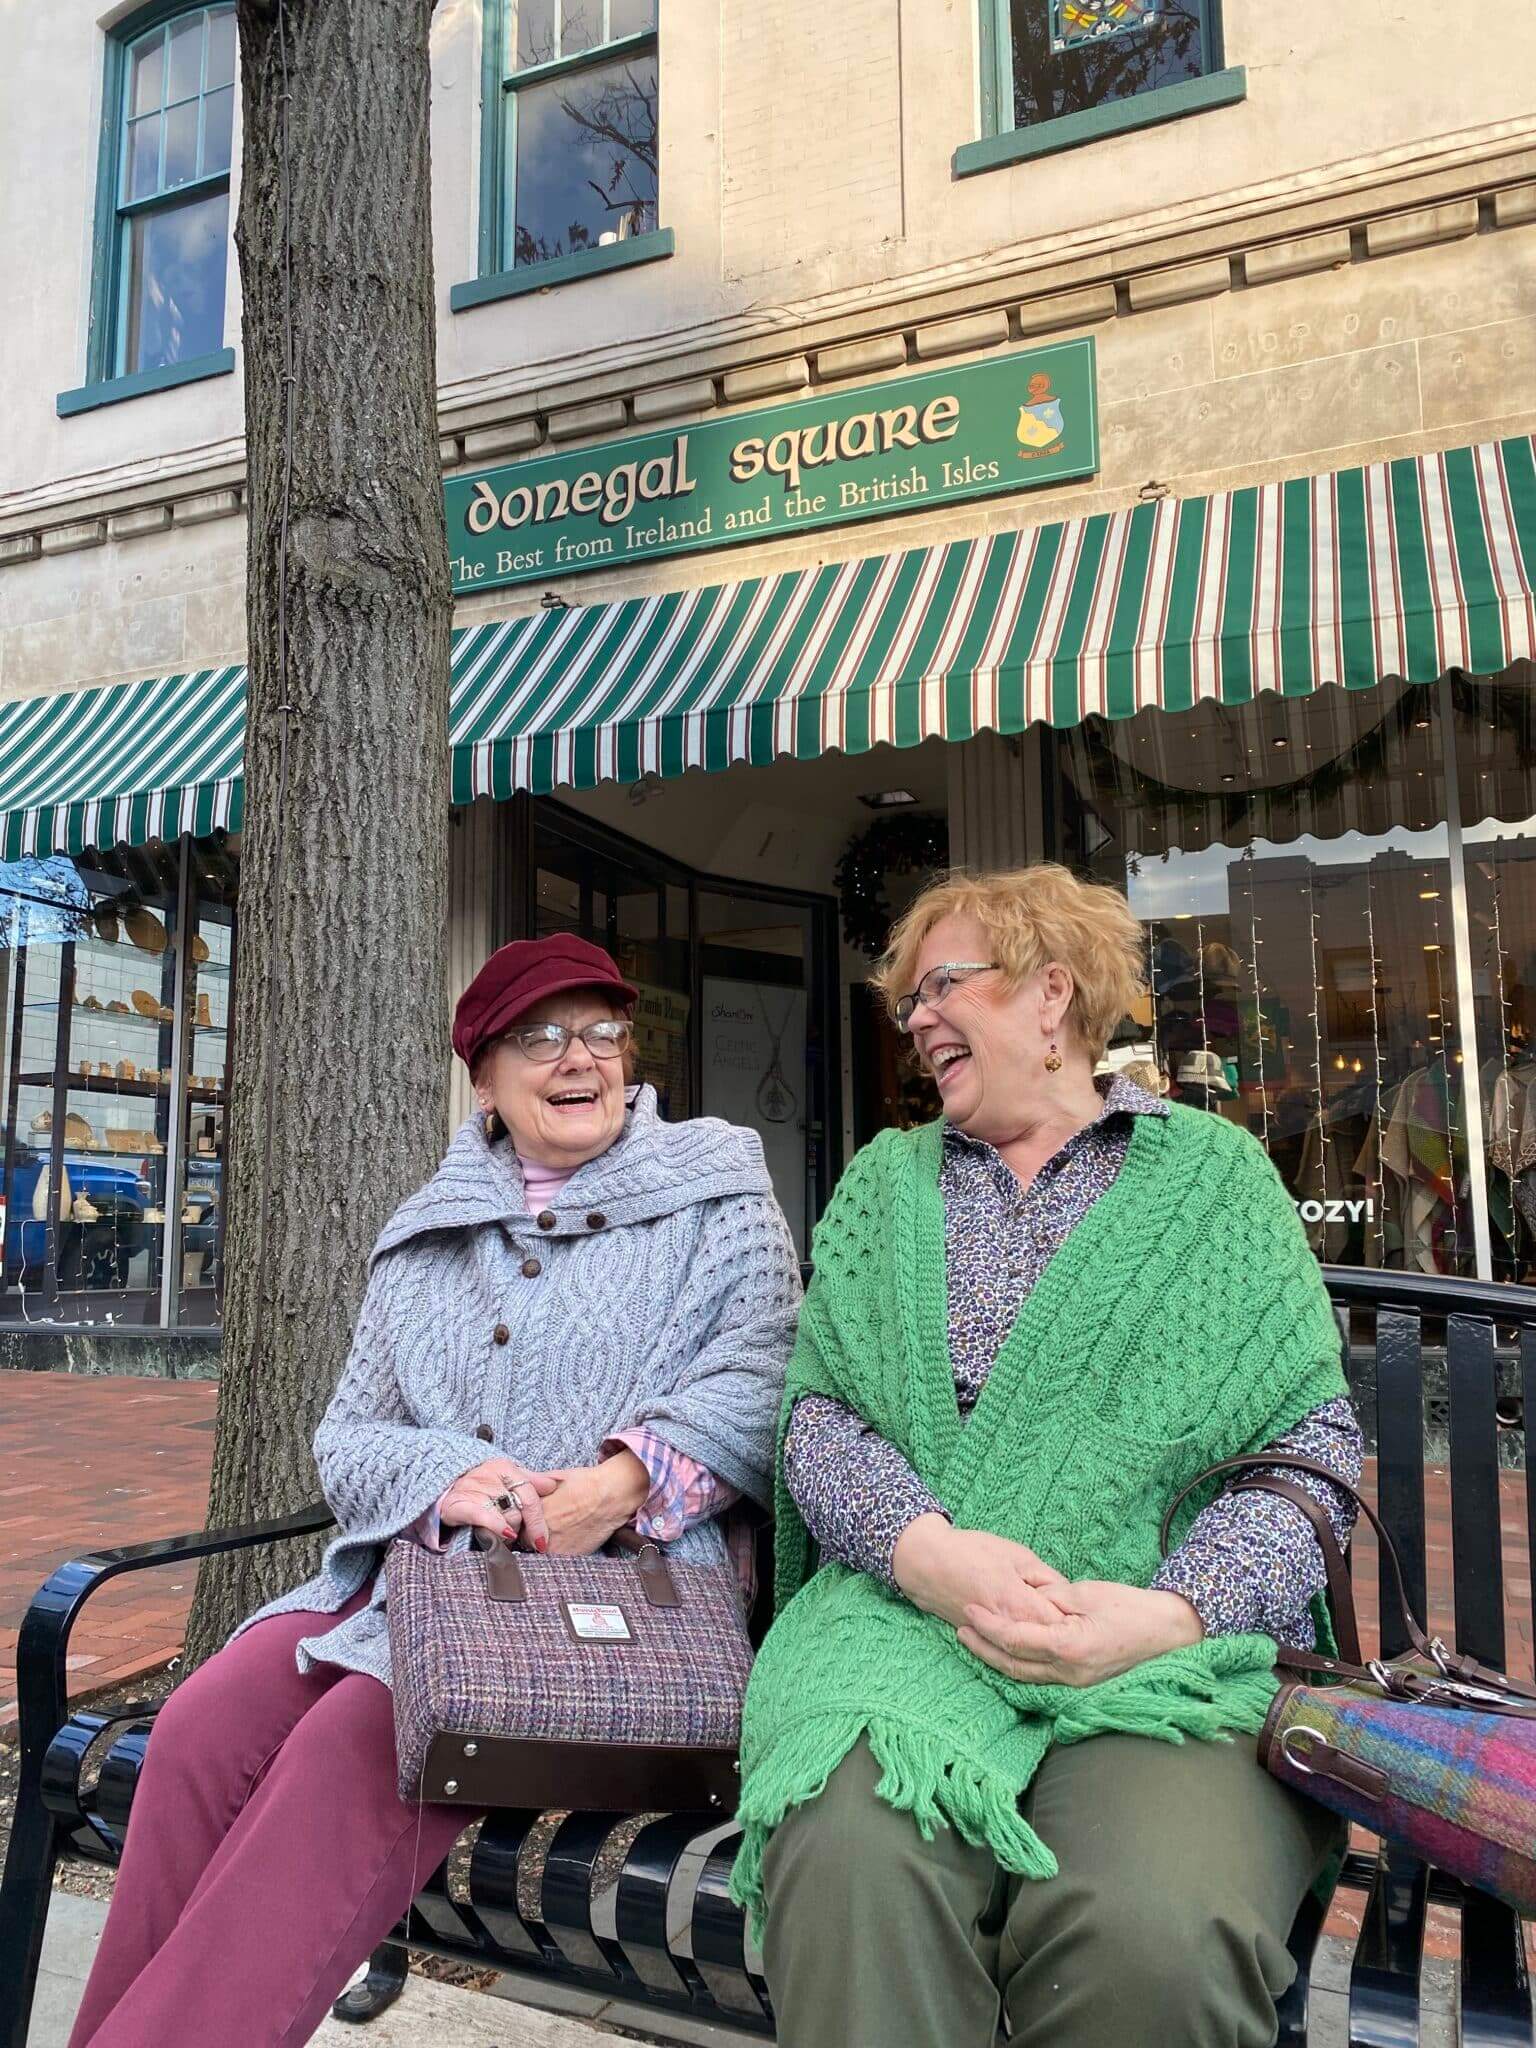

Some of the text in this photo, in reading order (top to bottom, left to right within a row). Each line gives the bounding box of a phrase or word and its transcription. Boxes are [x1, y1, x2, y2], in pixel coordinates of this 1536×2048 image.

[496, 548, 544, 575] Best
[555, 536, 613, 562] from
[625, 507, 713, 550] Ireland
[724, 496, 772, 531] and
[784, 489, 827, 519] the
[839, 466, 929, 508] British
[942, 455, 1000, 488] Isles
[1294, 1198, 1374, 1223] OZY!
